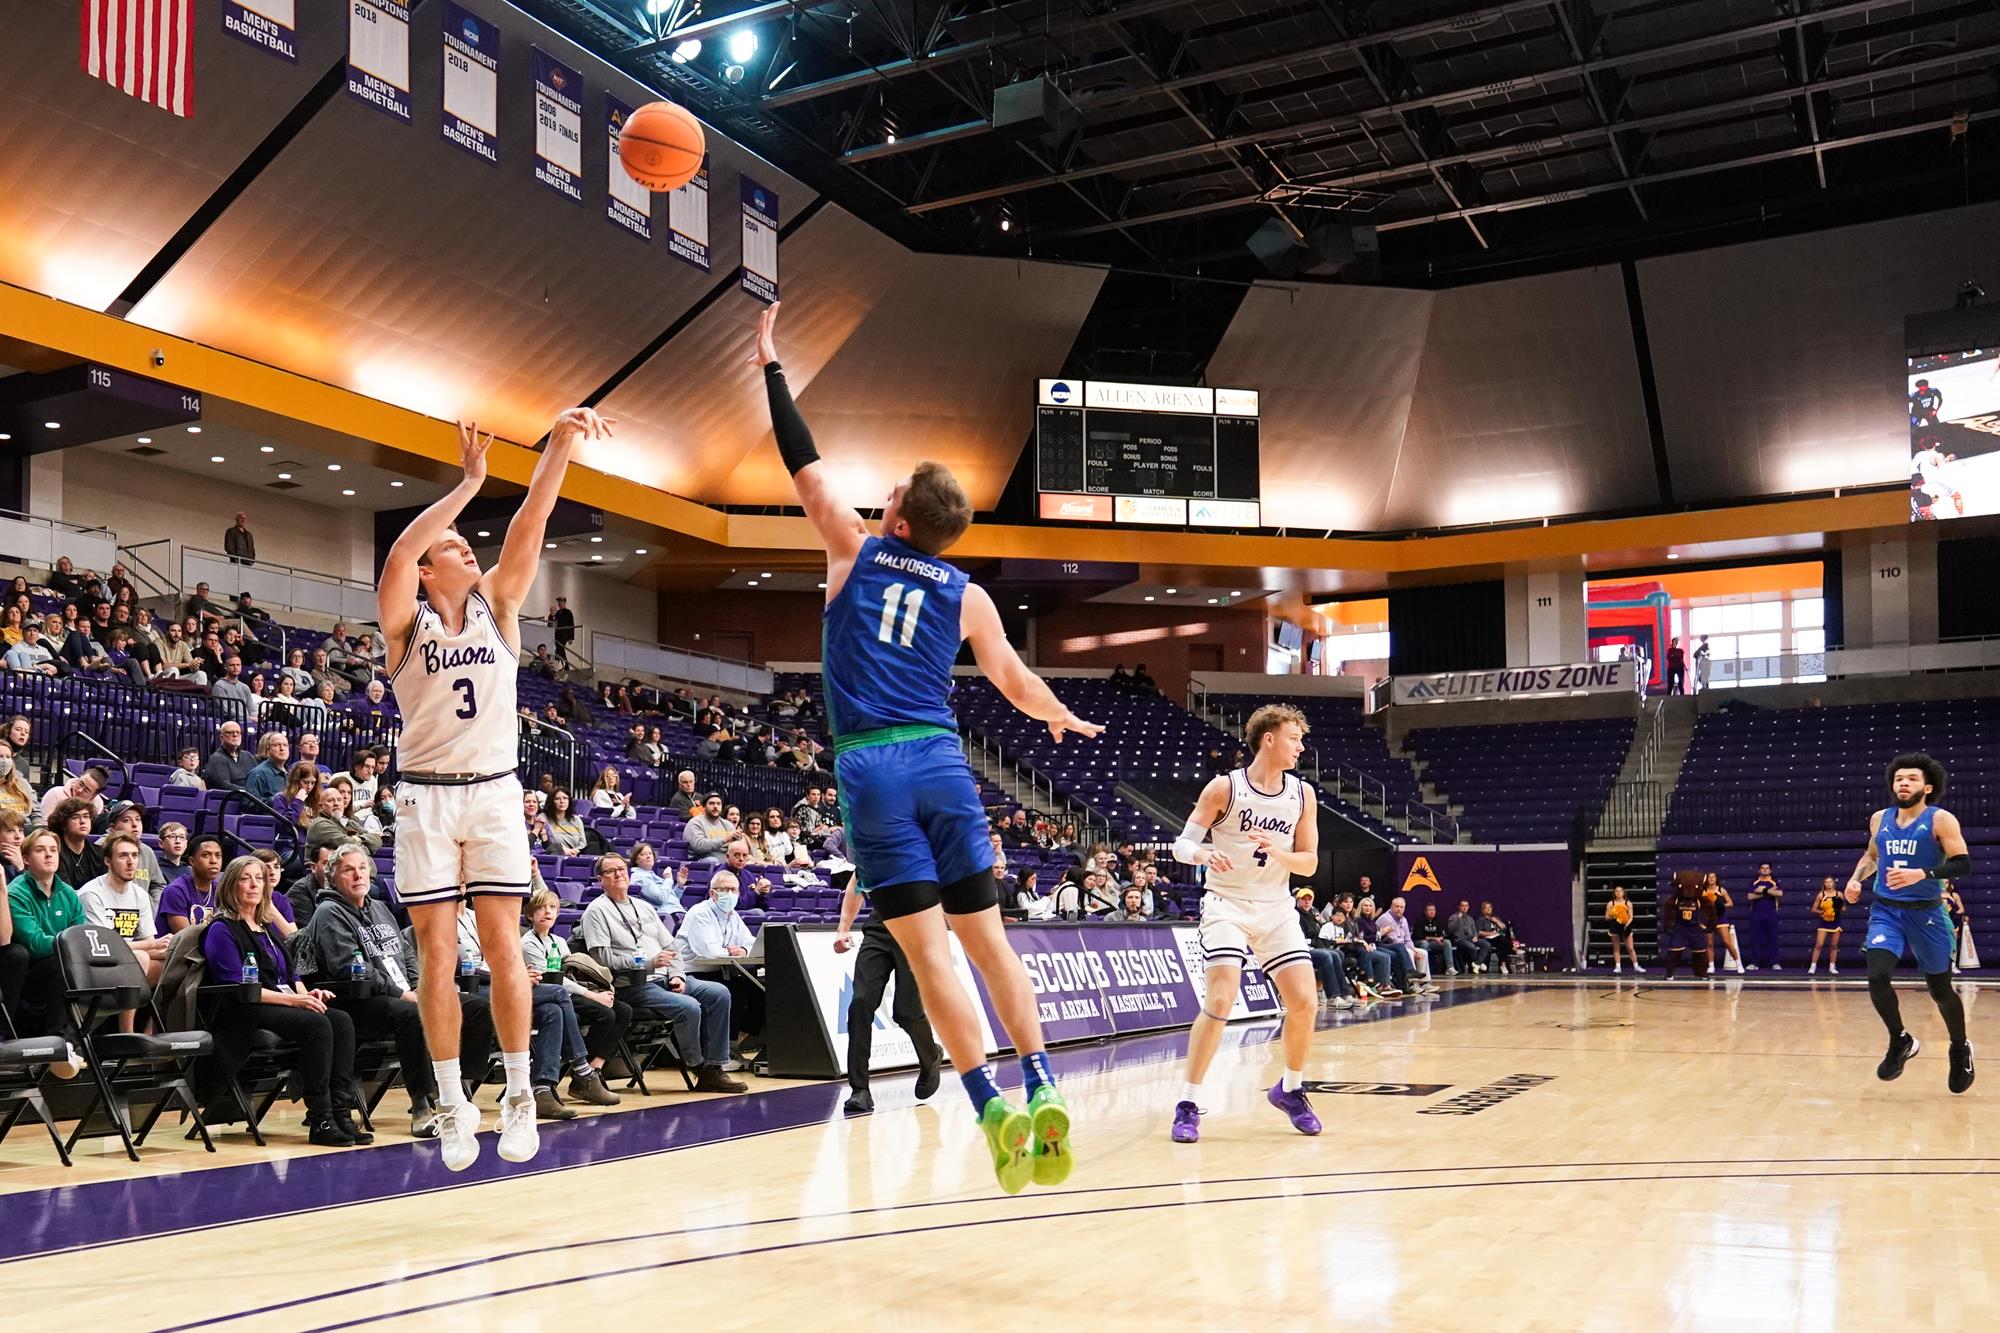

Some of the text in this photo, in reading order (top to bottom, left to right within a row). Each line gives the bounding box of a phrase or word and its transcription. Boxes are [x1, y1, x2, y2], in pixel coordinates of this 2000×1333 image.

[243, 10, 278, 36] MEN'S
[355, 4, 377, 24] 2018
[225, 15, 295, 58] BASKETBALL
[443, 31, 498, 70] TOURNAMENT
[448, 52, 469, 73] 2018
[364, 74, 395, 99] MEN'S
[535, 80, 581, 114] TOURNAMENT
[349, 80, 410, 118] BASKETBALL
[456, 120, 484, 143] MEN'S
[539, 113, 579, 143] 2019 FINALS
[443, 124, 497, 162] BASKETBALL
[535, 167, 582, 201] BASKETBALL
[546, 162, 571, 183] MEN'S
[608, 208, 651, 239] BASKETBALL
[613, 199, 646, 225] WOMEN'S
[742, 202, 777, 229] TOURNAMENT
[669, 241, 709, 268] BASKETBALL
[673, 232, 705, 256] WOMEN'S
[742, 279, 777, 302] BASKETBALL
[747, 271, 774, 292] WOMEN'S
[90, 369, 111, 388] 115
[180, 395, 200, 413] 114
[1096, 388, 1205, 408] ALLEN ARENA
[1123, 443, 1138, 451] POSS
[1139, 437, 1162, 445] PERIOD
[1164, 445, 1178, 453] POSS
[1123, 453, 1141, 461] BONUS
[1143, 488, 1165, 496] MATCH
[1193, 490, 1214, 498] SCORE
[590, 513, 602, 526] 113
[874, 551, 950, 584] HALVORSEN
[1062, 563, 1079, 574] 112
[1879, 566, 1901, 578] 110
[1536, 597, 1551, 607] 111
[878, 582, 926, 648] 11
[419, 640, 495, 675] Bisons
[1435, 663, 1621, 696] ELITE KIDS ZONE
[452, 677, 477, 719] 3
[1239, 808, 1292, 835] Bisons
[1253, 846, 1268, 867] 4
[1886, 839, 1917, 856] FGCU
[85, 930, 110, 957] L
[1021, 951, 1111, 993] SCOMB
[1105, 948, 1184, 987] BISONS
[1038, 991, 1177, 1023] LEN ARENA NASHVILLE, TN
